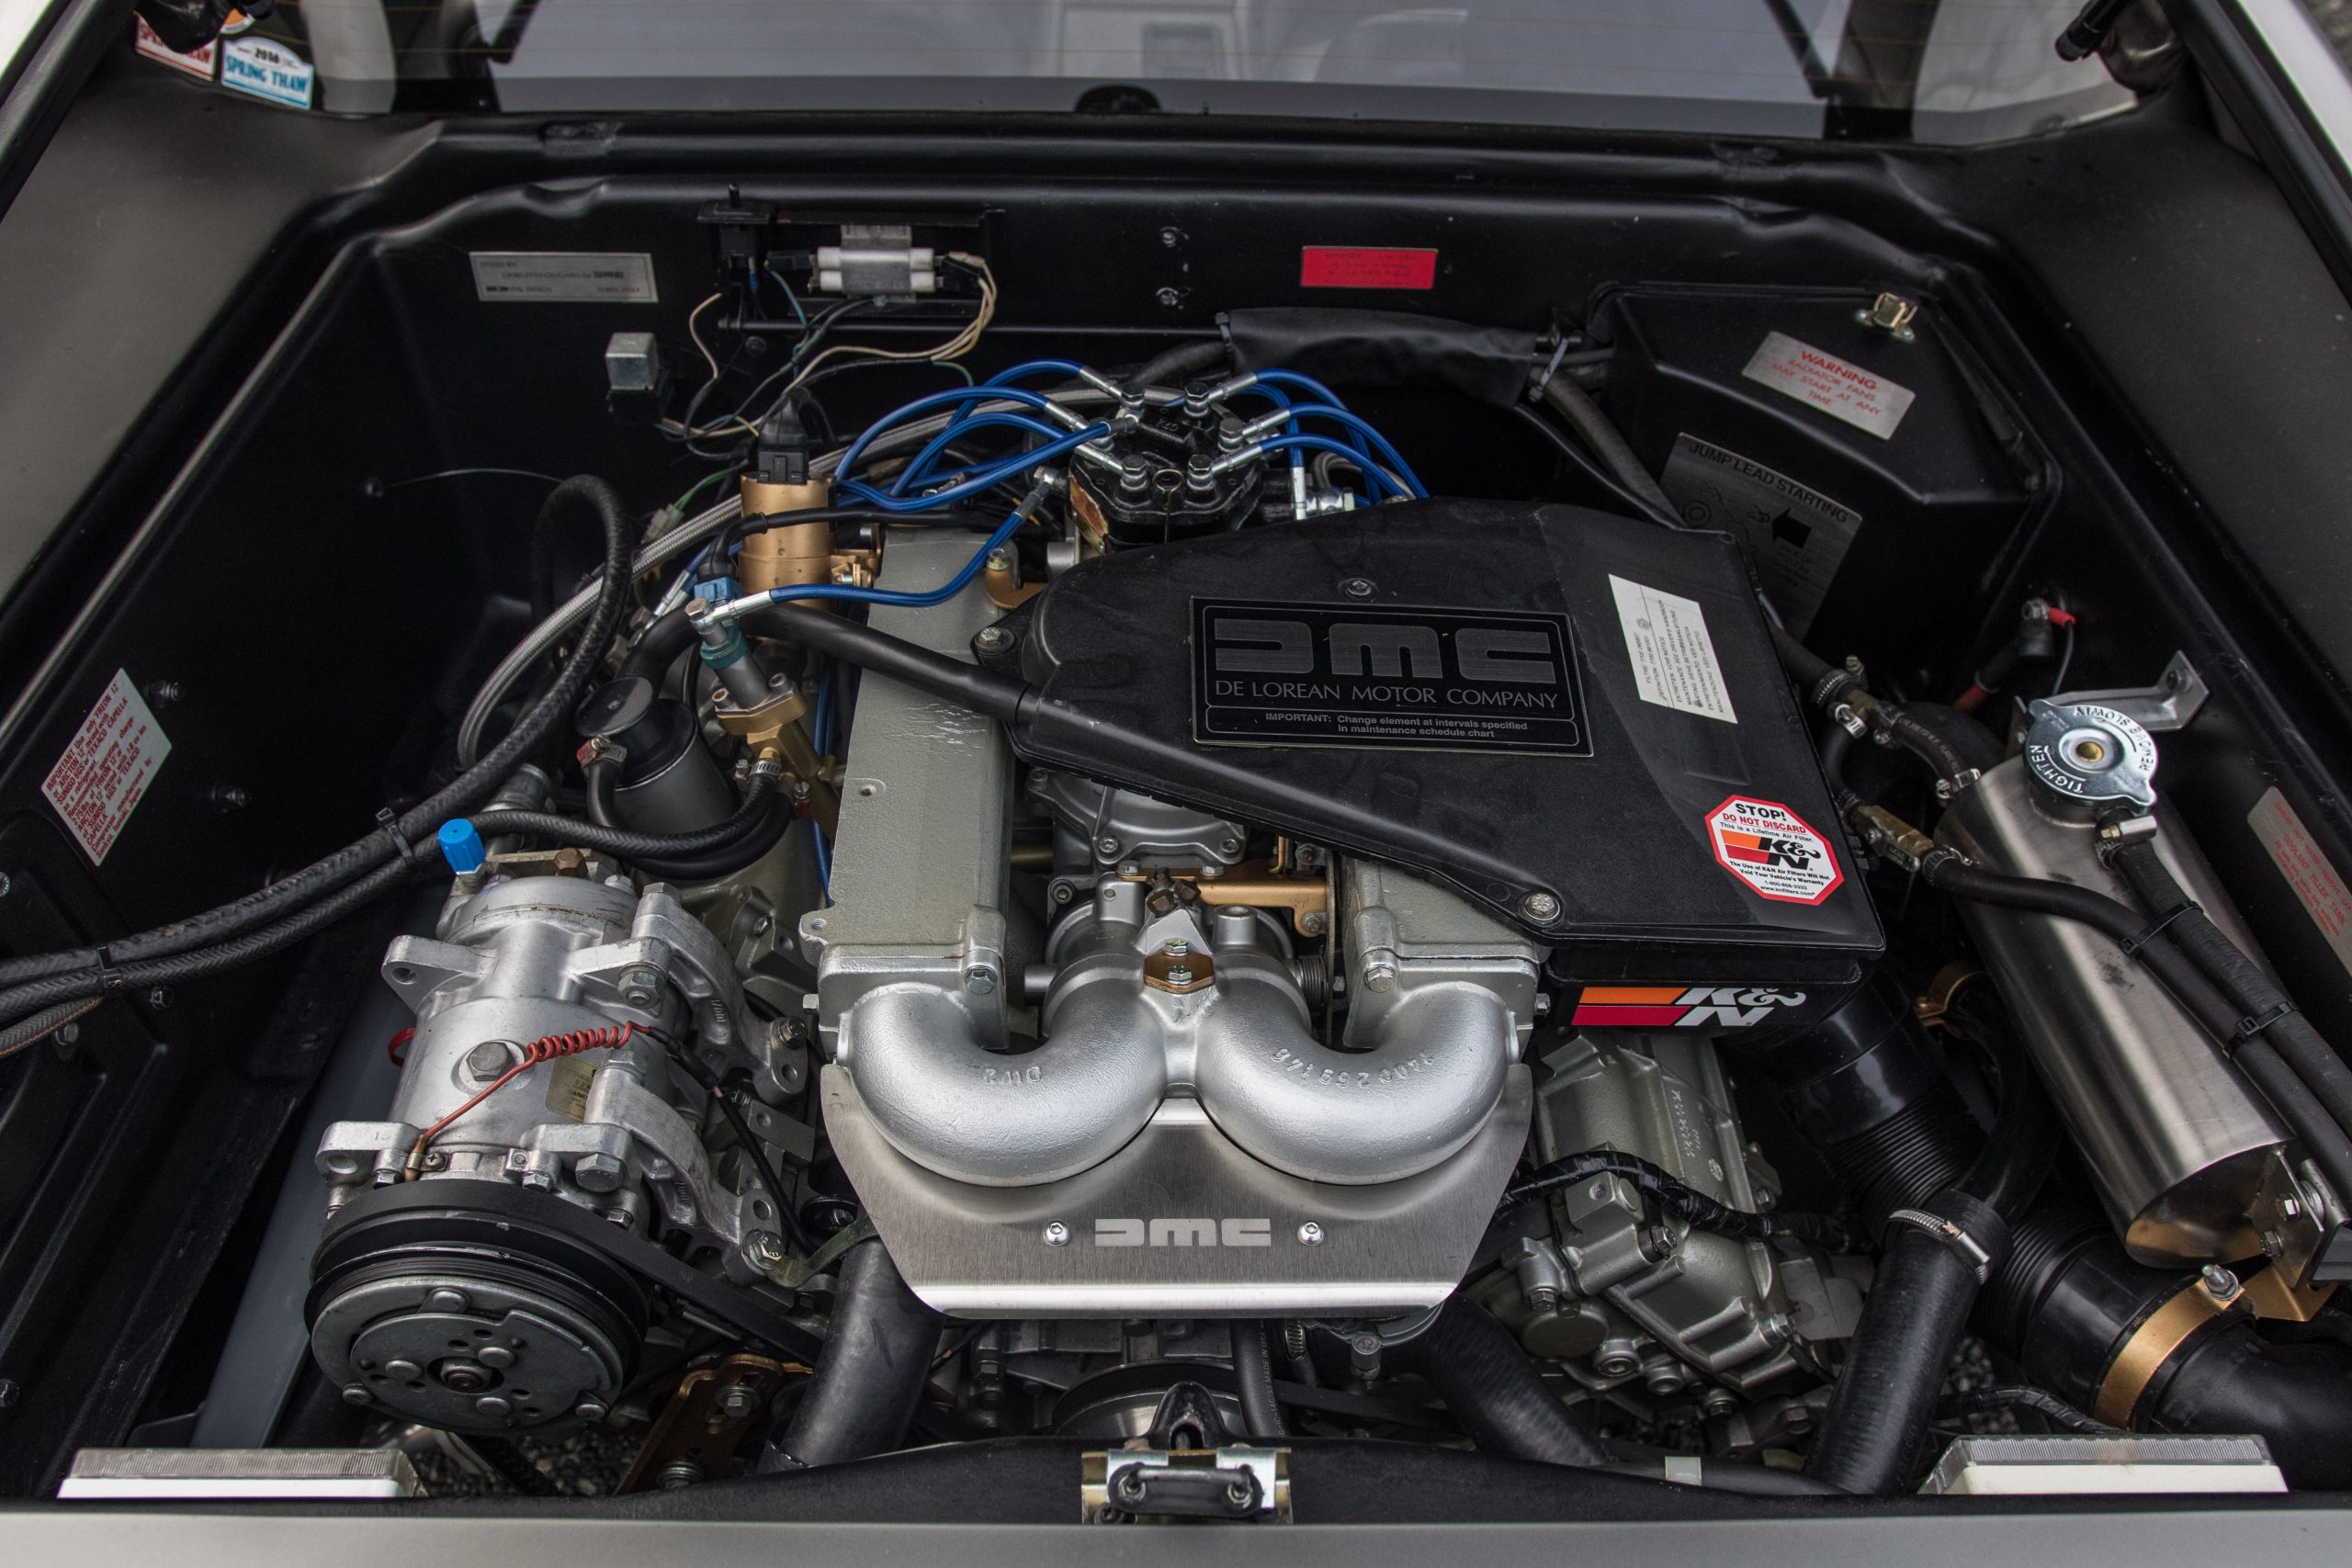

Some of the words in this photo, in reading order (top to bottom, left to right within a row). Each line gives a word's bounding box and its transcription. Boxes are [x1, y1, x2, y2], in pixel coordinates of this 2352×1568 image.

[226, 55, 266, 82] SPRING
[272, 70, 307, 93] THAW
[1788, 359, 1840, 384] RADIATOR
[1847, 385, 1875, 400] FANS
[1799, 351, 1877, 389] WARNING
[1801, 377, 1830, 391] START
[1837, 392, 1849, 400] AT
[1855, 400, 1880, 414] ANY
[1808, 390, 1831, 404] TIME
[1689, 441, 1733, 467] JUMP
[1734, 458, 1775, 486] LEAD
[1777, 479, 1849, 525] STARTING
[1216, 680, 1245, 696] DE
[1251, 681, 1340, 700] LOREAN
[1351, 683, 1439, 704] MOTOR
[1446, 688, 1559, 709] COMPANY
[74, 734, 84, 749] Use
[85, 716, 96, 733] only
[1265, 712, 1332, 724] IMPORTANT:
[1337, 715, 1377, 728] Change
[1379, 716, 1420, 728] element
[1422, 718, 1433, 728] at
[1435, 718, 1478, 729] intervals
[1481, 720, 1528, 733] specified
[1350, 725, 1418, 737] maintenance
[1419, 726, 1466, 738] schedule
[1467, 728, 1495, 739] chart
[51, 787, 58, 797] or
[97, 712, 108, 728] with
[117, 753, 127, 770] with
[67, 772, 98, 818] Recommended
[98, 739, 119, 771] operating
[2030, 745, 2084, 794] TIGHTEN
[88, 790, 95, 799] of
[62, 801, 69, 812] as
[1735, 803, 1787, 821] STOP!
[81, 828, 87, 838] of
[1722, 813, 1736, 822] DO
[1739, 816, 1760, 826] NOT
[1763, 820, 1806, 833] DISCARD
[1752, 828, 1780, 837] Lifetime
[1758, 836, 1821, 871] K&N
[1739, 868, 1754, 876] Void
[1755, 870, 1769, 878] Your
[1770, 873, 1797, 882] Vehicle's
[1798, 877, 1824, 886] Warranty
[1786, 869, 1806, 877] Filters
[1674, 987, 1806, 1026] K&N
[1261, 1348, 1268, 1358] IN
[1263, 1359, 1272, 1383] MADE
